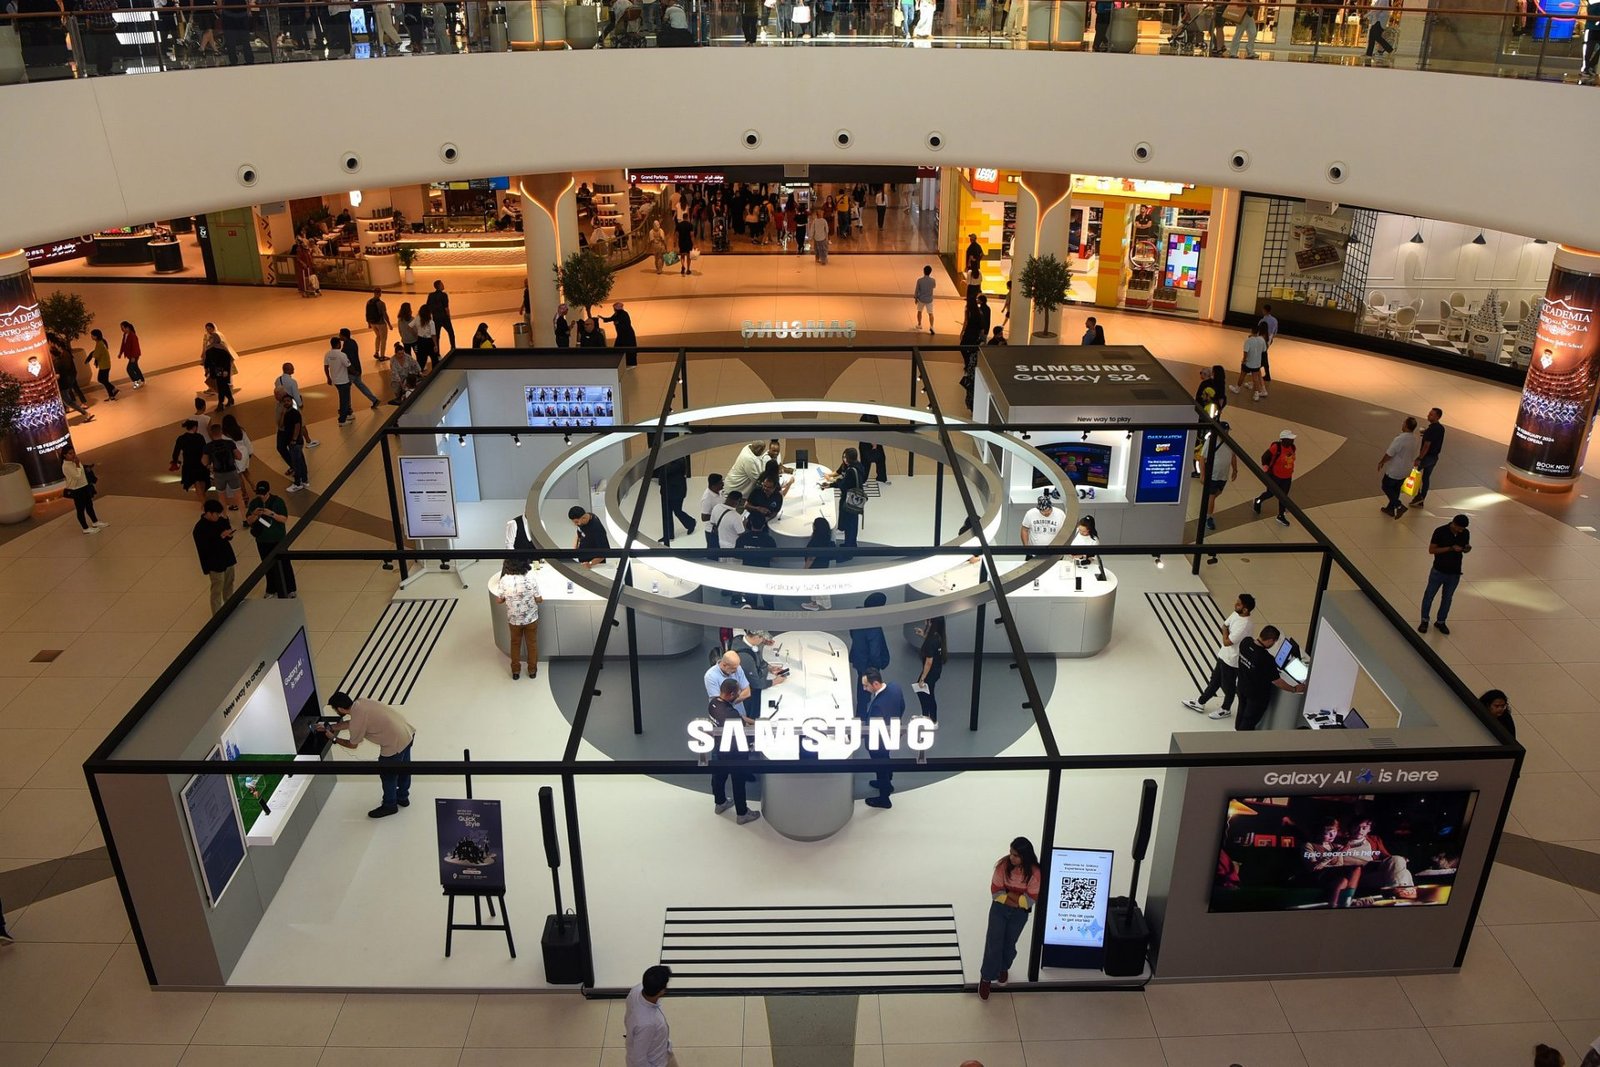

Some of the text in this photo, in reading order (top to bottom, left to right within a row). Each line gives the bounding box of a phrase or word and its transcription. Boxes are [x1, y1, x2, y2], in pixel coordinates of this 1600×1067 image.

[976, 168, 996, 181] LEGO
[1542, 303, 1591, 323] CCADEMIA
[1015, 364, 1136, 372] SAMSUNG
[1013, 374, 1151, 384] Galaxy S24
[1117, 416, 1131, 424] play
[1536, 461, 1555, 469] BOOK
[1033, 519, 1057, 527] ORIGINAL
[766, 583, 800, 592] Galaxy
[284, 666, 297, 686] Galaxy
[293, 669, 304, 684] here
[223, 660, 266, 718] New way to create
[687, 717, 936, 753] SAMSUNG
[1263, 768, 1439, 788] Galaxy AI is here
[1304, 850, 1321, 859] Epic
[1322, 850, 1352, 858] search
[1360, 849, 1380, 857] here
